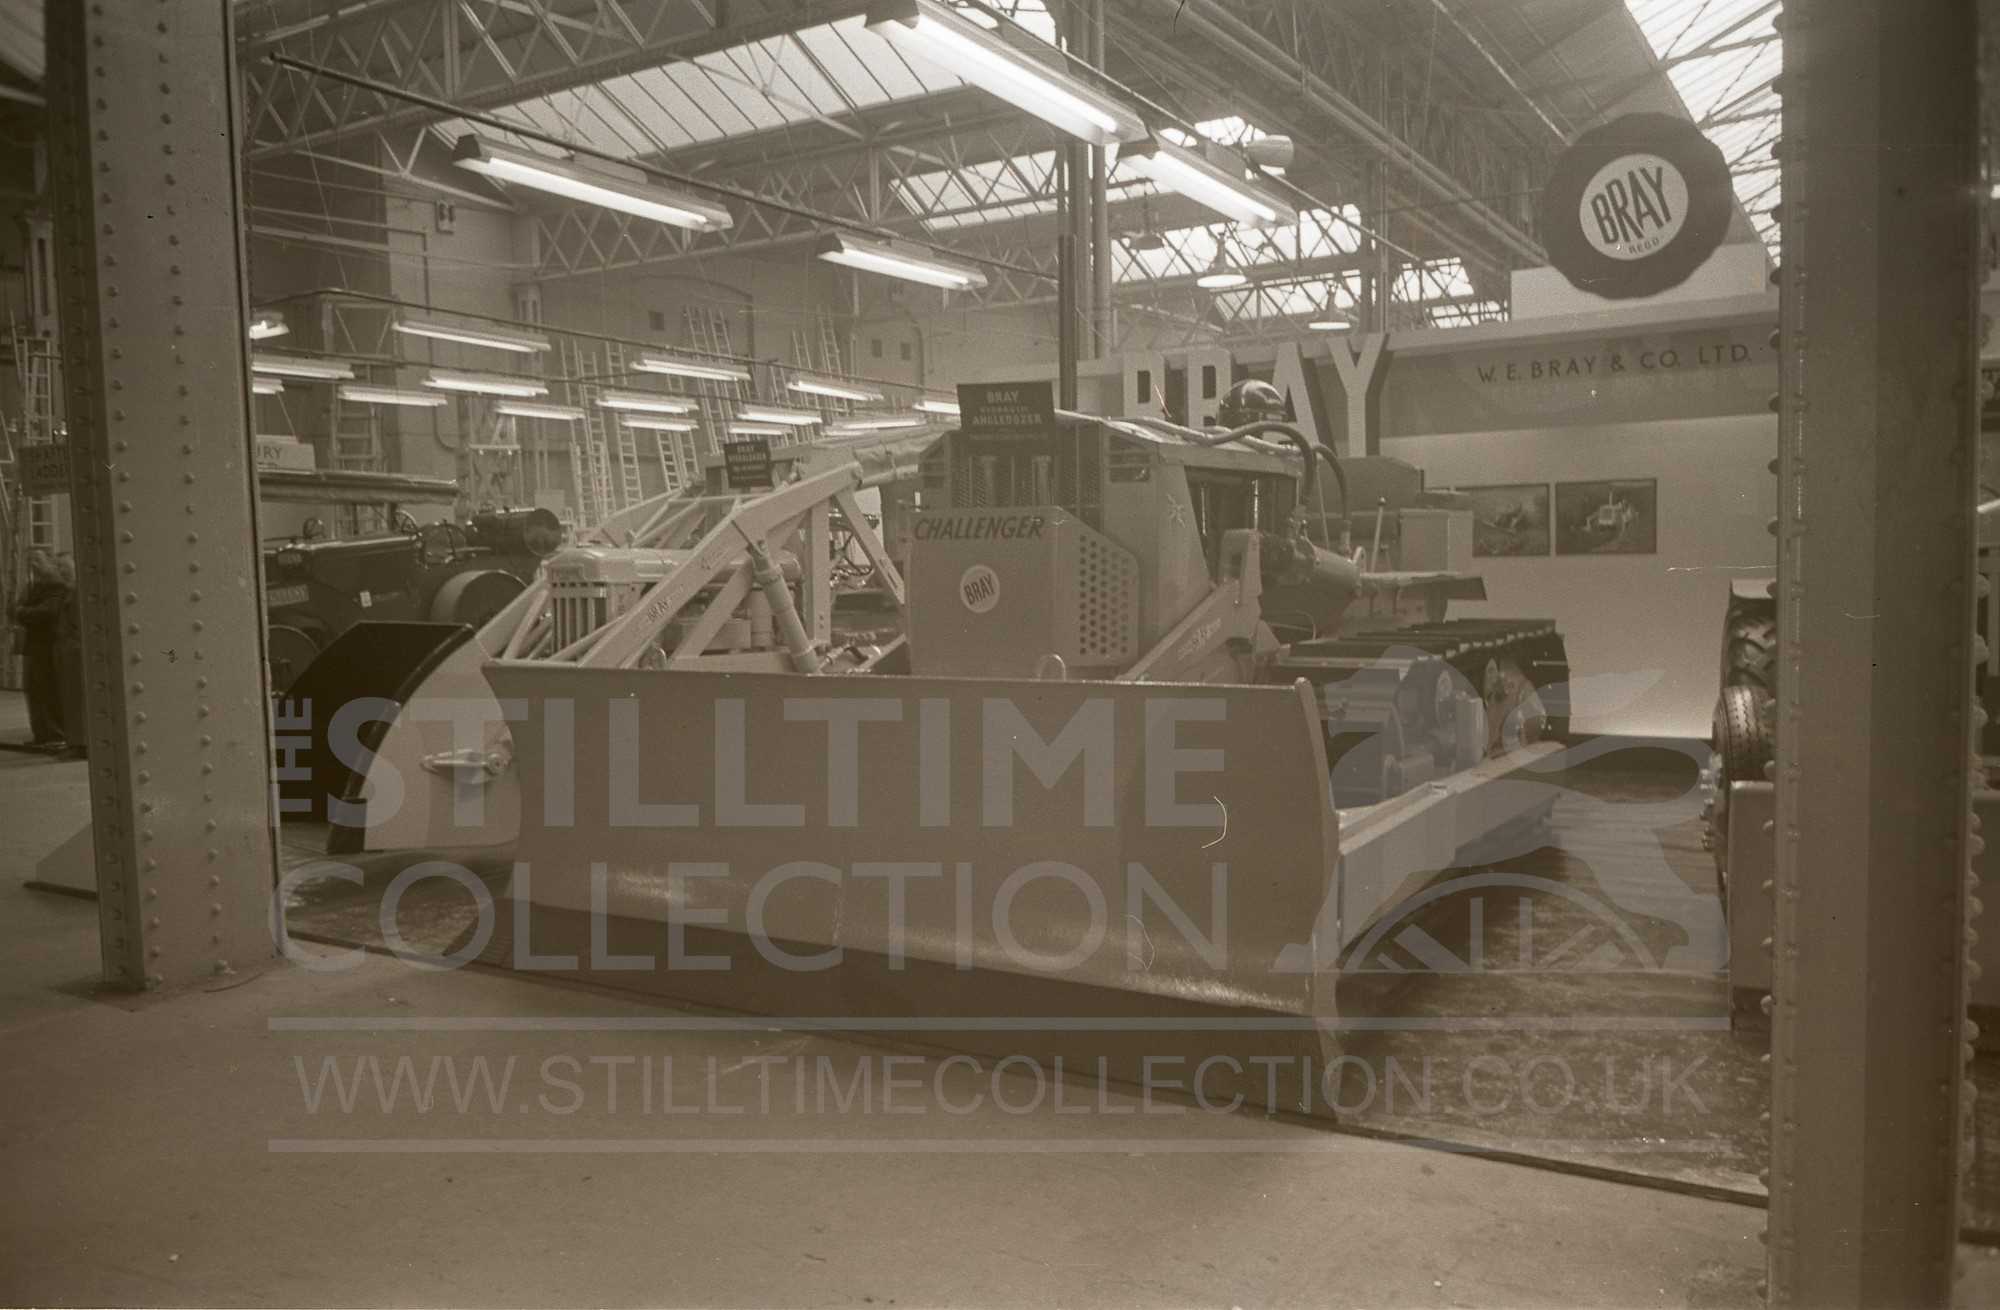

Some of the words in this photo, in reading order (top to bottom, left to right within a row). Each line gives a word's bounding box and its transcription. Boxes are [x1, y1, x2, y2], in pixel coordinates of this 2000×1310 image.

[1591, 167, 1672, 244] BRAY
[1530, 355, 1597, 379] BRAY
[1610, 353, 1626, 372] &
[1640, 350, 1681, 369] CO.
[1698, 344, 1753, 365] LTD.
[986, 390, 1019, 403] BRAY
[1121, 338, 1386, 457] BRAY
[972, 413, 1043, 425] ANGLEDOZER
[914, 515, 1045, 541] CHALLENGER
[963, 574, 996, 606] BRAY
